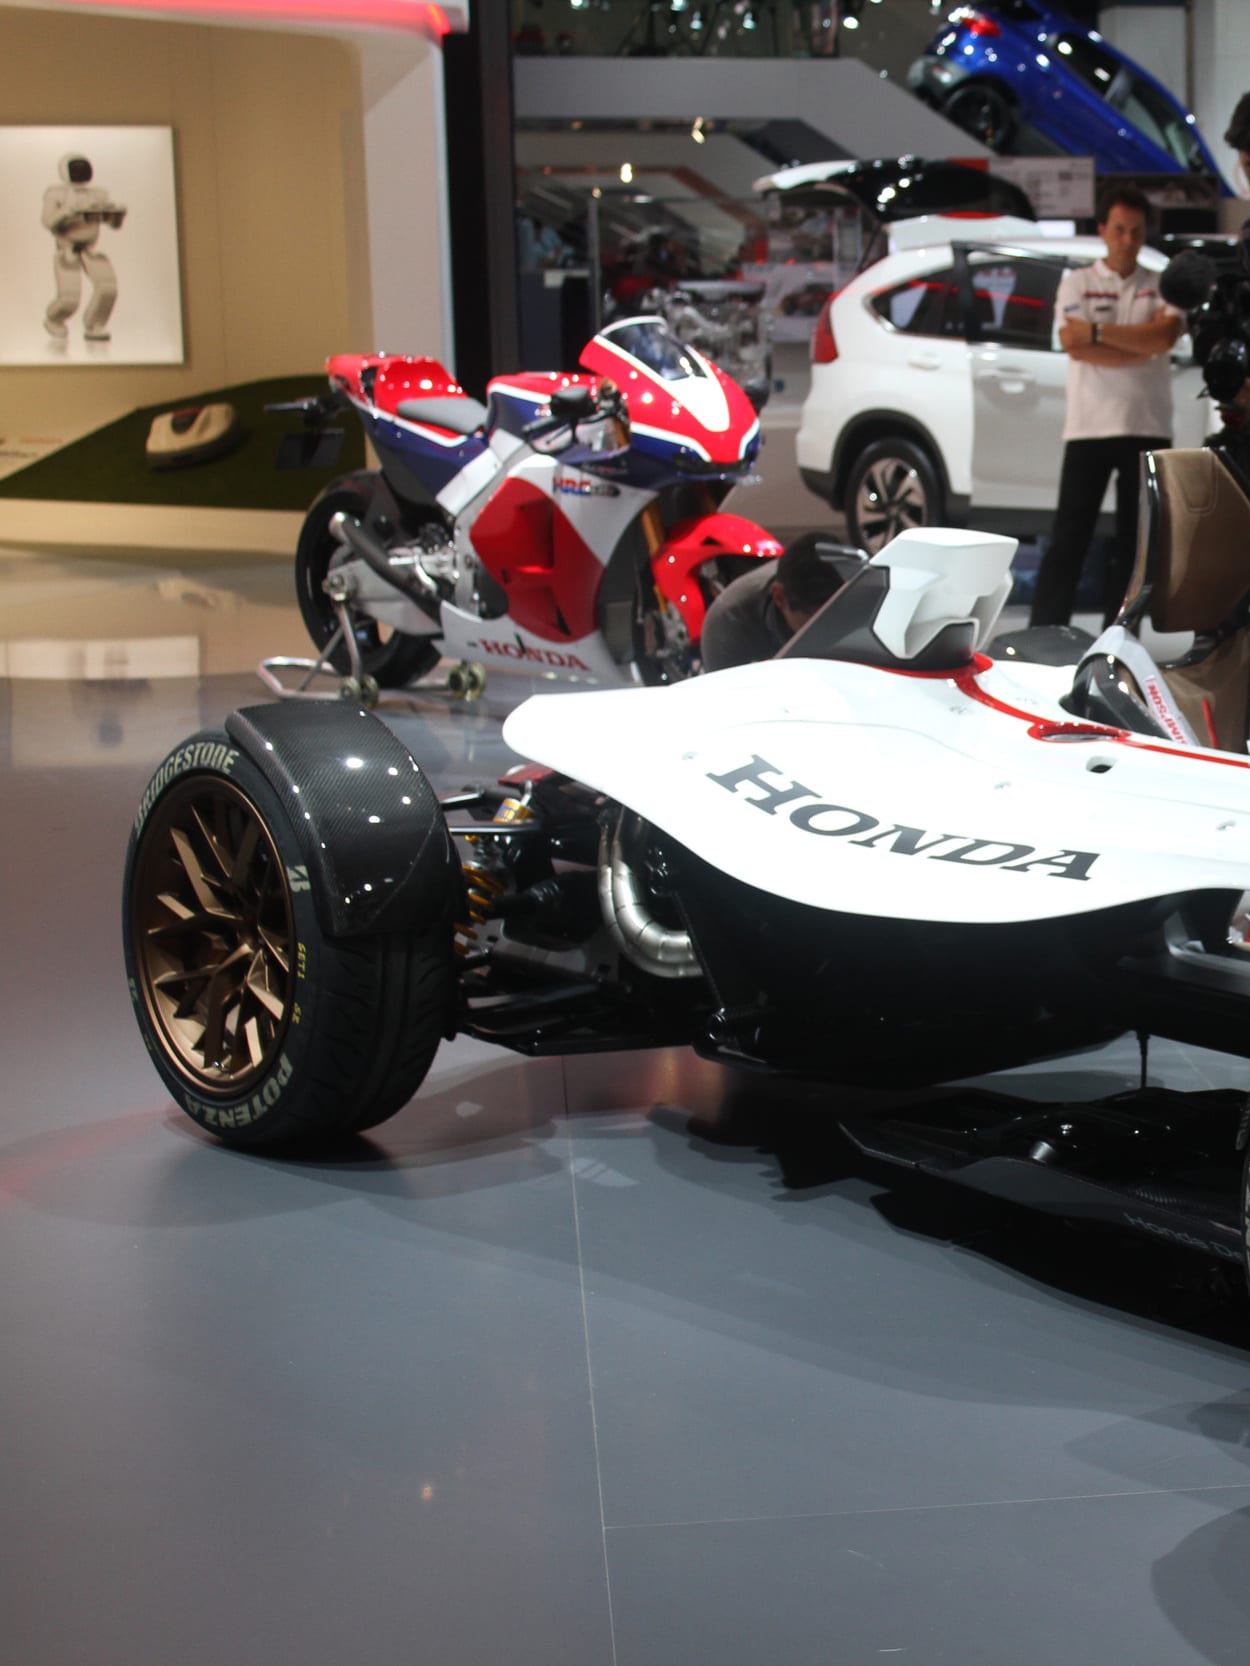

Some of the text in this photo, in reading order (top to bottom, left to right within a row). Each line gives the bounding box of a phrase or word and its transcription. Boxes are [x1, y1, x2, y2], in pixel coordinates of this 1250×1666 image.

[478, 638, 592, 672] HONDA
[134, 742, 240, 838] BRIDGESTONE
[706, 754, 1101, 881] HONDA
[185, 1052, 293, 1129] POTENZA
